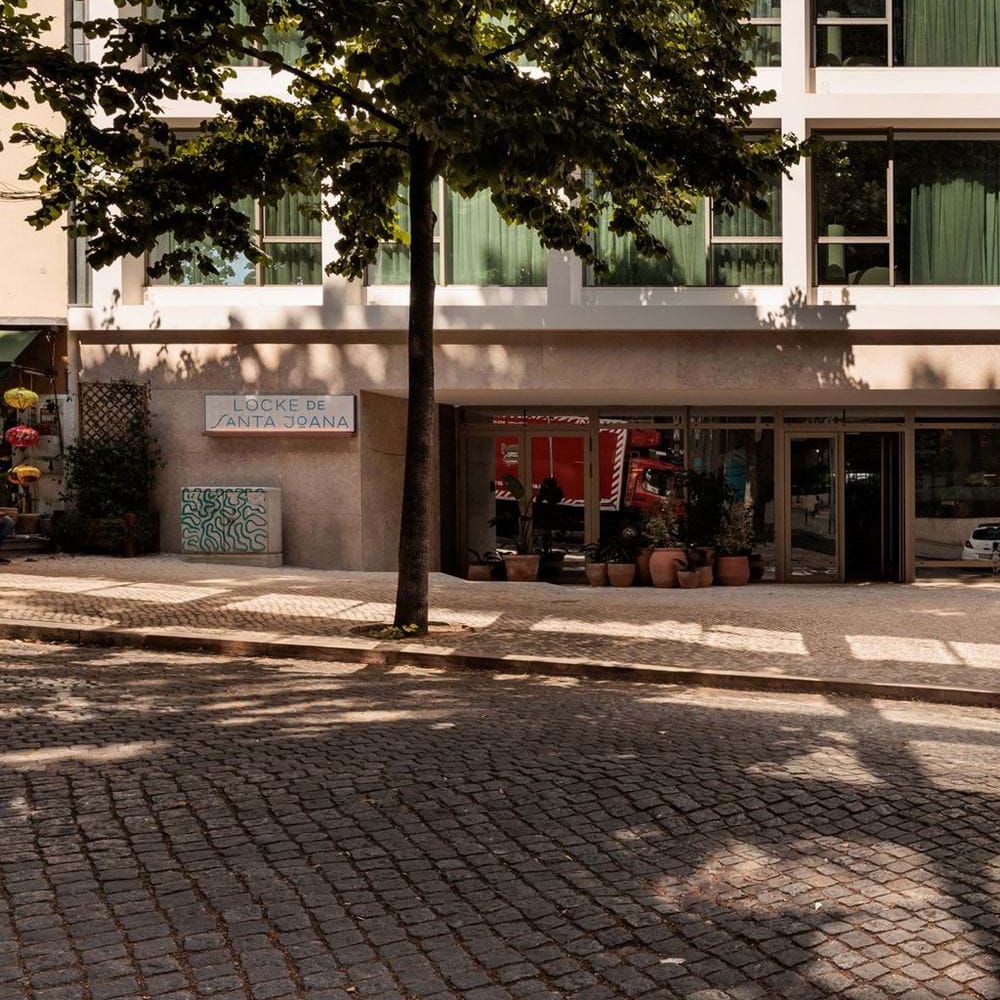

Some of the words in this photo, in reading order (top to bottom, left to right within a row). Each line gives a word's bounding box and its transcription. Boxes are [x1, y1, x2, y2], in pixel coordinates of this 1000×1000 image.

[233, 398, 299, 412] LOCKE
[306, 400, 325, 411] DE
[210, 413, 276, 429] SANTA
[283, 415, 349, 429] JOANA
